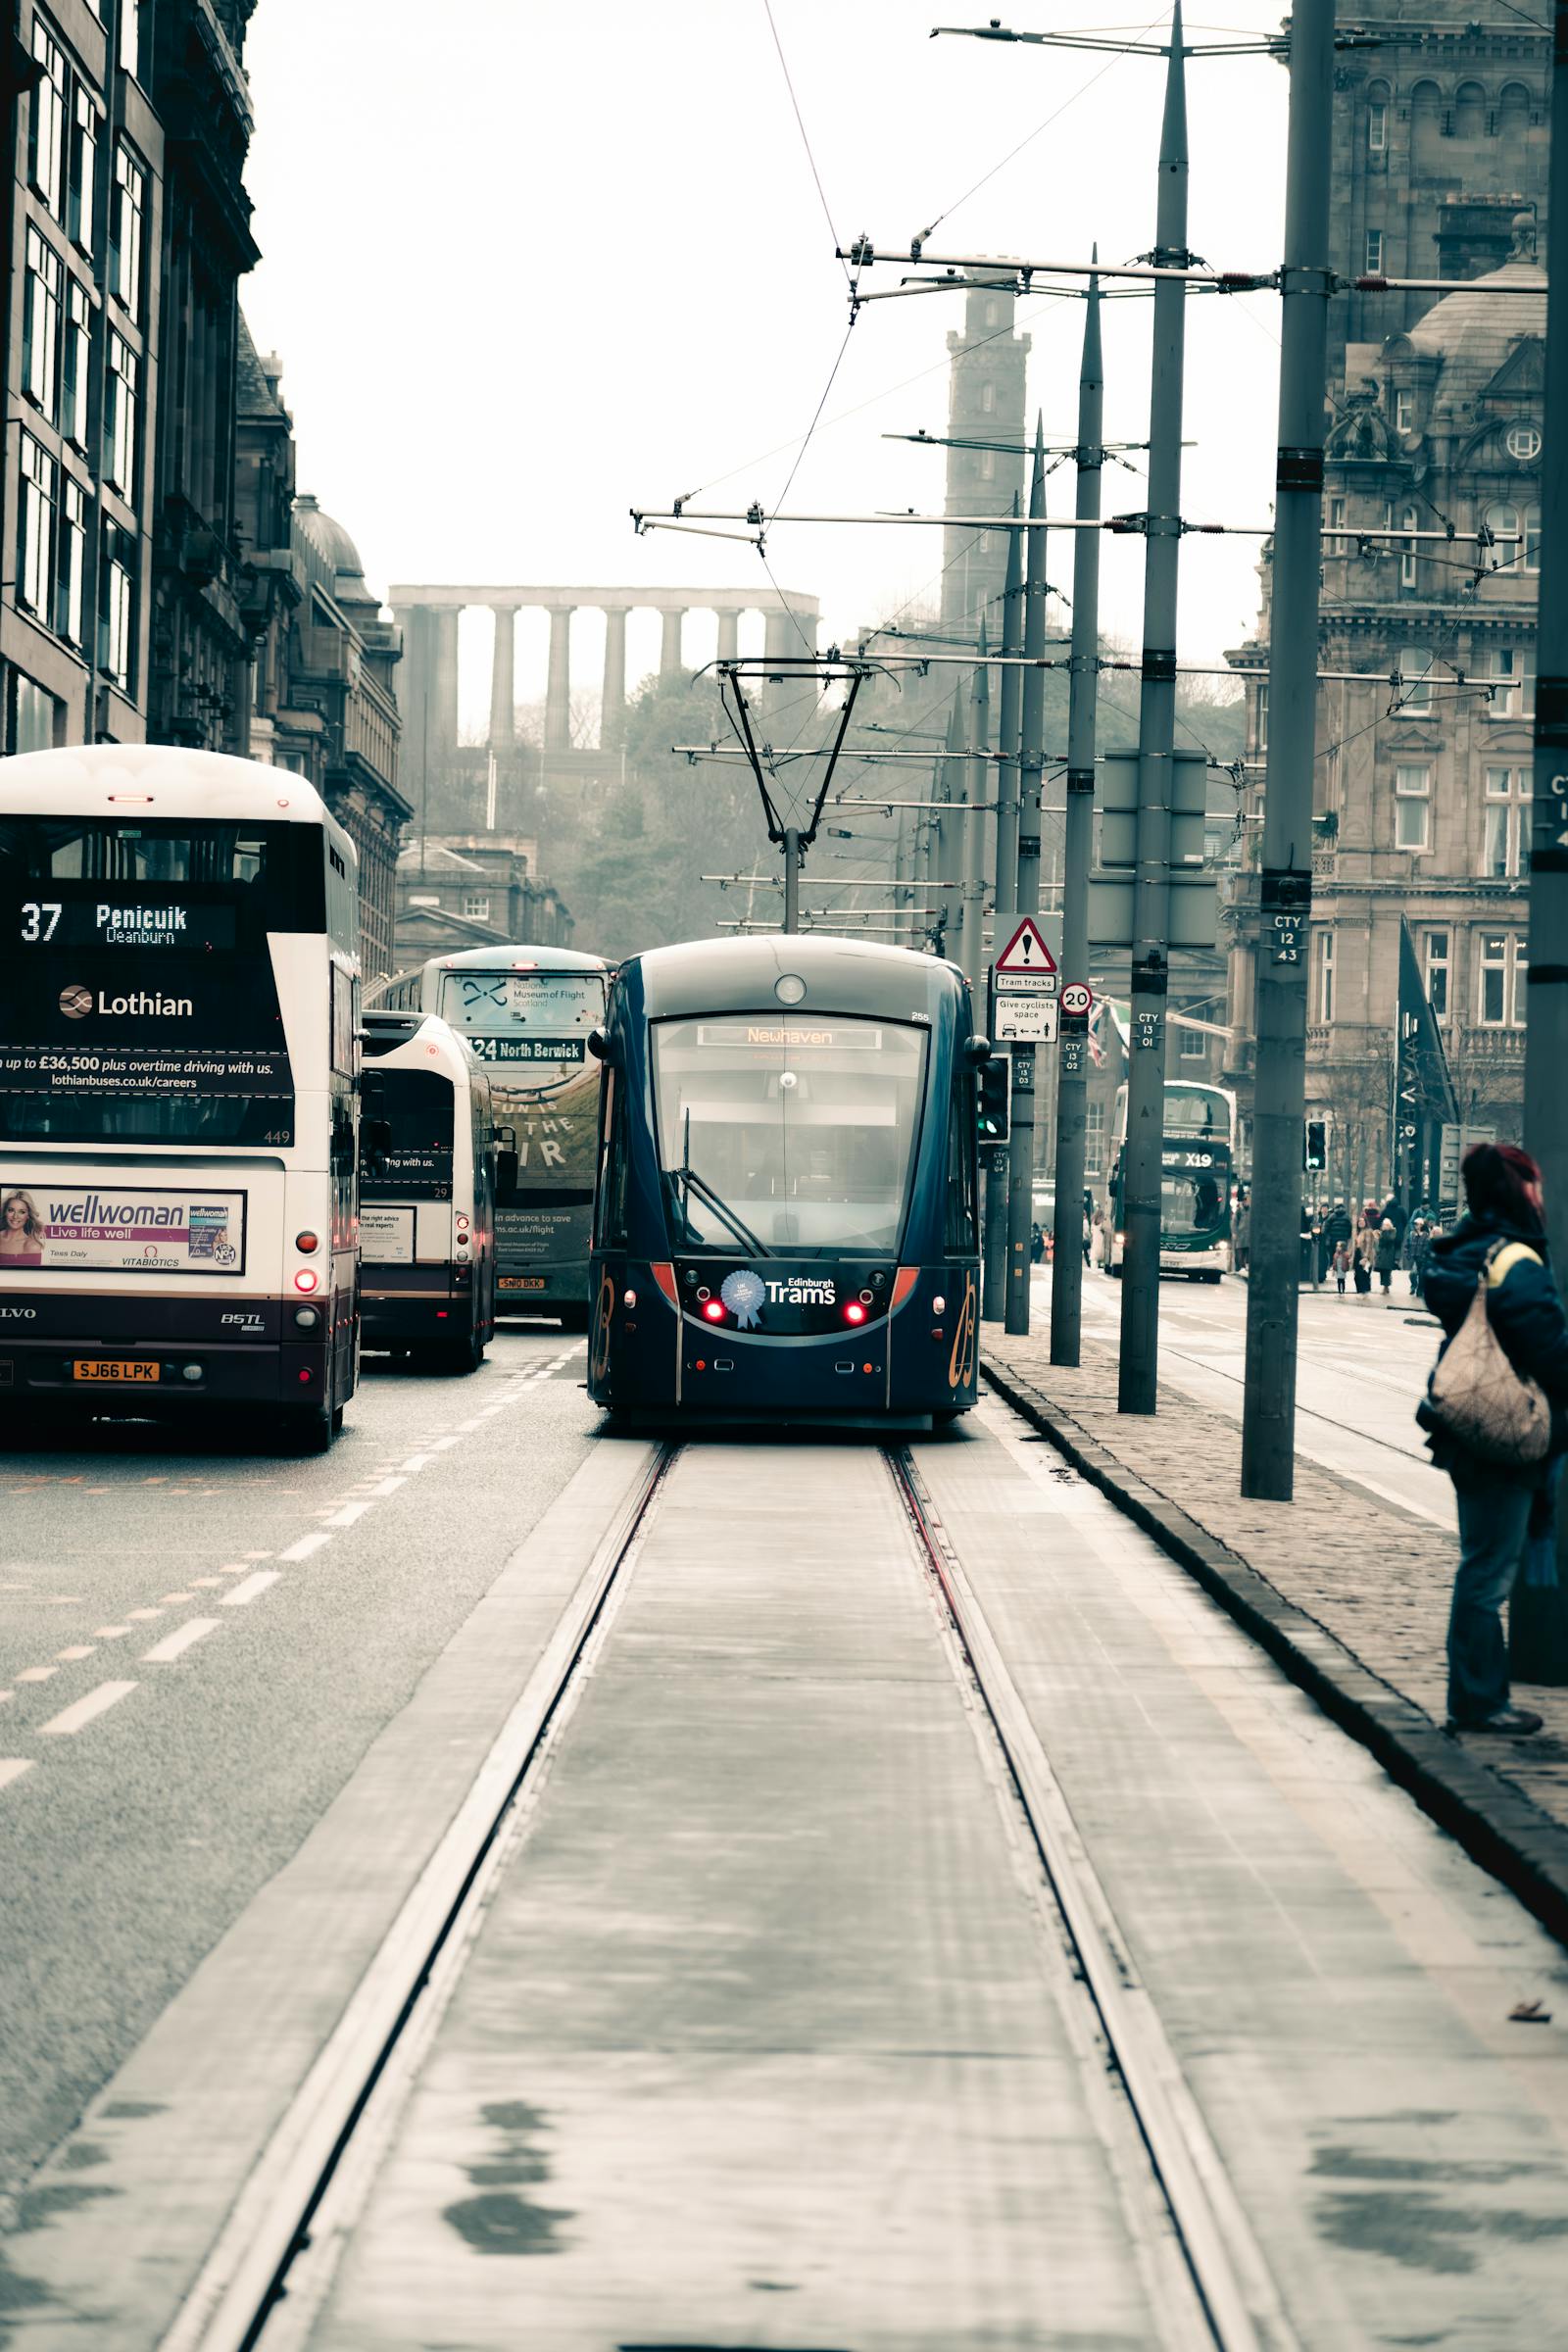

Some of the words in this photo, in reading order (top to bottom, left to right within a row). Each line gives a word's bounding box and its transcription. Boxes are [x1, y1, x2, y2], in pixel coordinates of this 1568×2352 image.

[21, 903, 62, 941] 37
[96, 905, 187, 930] Penicuik
[1274, 915, 1301, 928] CTY
[106, 926, 174, 945] Deanburn
[1280, 932, 1294, 945] 12
[1277, 949, 1298, 961] 43
[560, 991, 585, 1000] Flight
[1065, 992, 1088, 1005] 20
[98, 991, 193, 1016] Lothian
[1020, 1002, 1054, 1010] cyclists
[911, 1011, 930, 1022] 255
[1139, 1012, 1158, 1023] CTY
[748, 1028, 833, 1045] Newhaven
[1143, 1025, 1153, 1035] 13
[471, 1039, 497, 1060] 24
[500, 1042, 531, 1057] North
[534, 1043, 579, 1058] Berwick
[6, 1058, 22, 1071] up
[24, 1057, 37, 1069] to
[39, 1055, 100, 1072] £36,500
[102, 1058, 126, 1072] plus
[128, 1059, 181, 1072] overtime
[183, 1060, 225, 1076] driving
[228, 1061, 254, 1074] with
[257, 1064, 273, 1075] us.
[51, 1073, 197, 1089] lothianbuses.co.uk/careers
[538, 1101, 558, 1113] IS
[524, 1117, 574, 1136] THE
[264, 1130, 290, 1144] 449
[402, 1157, 420, 1167] with
[422, 1158, 435, 1167] us.
[1185, 1152, 1212, 1168] X19
[434, 1188, 448, 1199] 29
[49, 1195, 183, 1226] wellwoman
[50, 1227, 77, 1239] Live
[81, 1227, 100, 1239] life
[104, 1228, 132, 1240] well
[122, 1257, 179, 1267] VITABIOTICS
[788, 1277, 834, 1289] Edinburgh
[764, 1281, 836, 1305] Trams
[80, 1363, 120, 1378] SJ66
[123, 1363, 153, 1379] LPK
